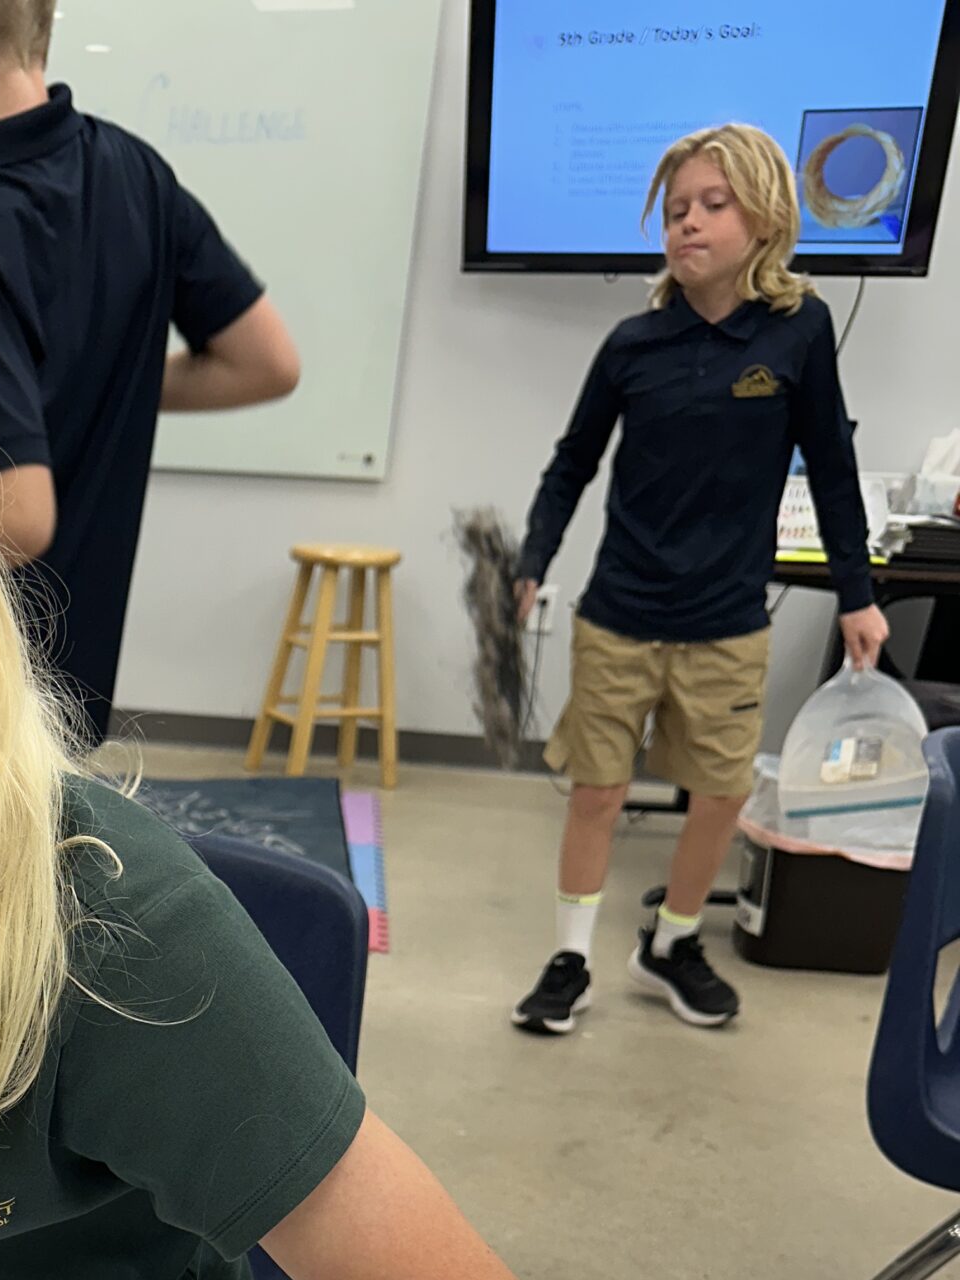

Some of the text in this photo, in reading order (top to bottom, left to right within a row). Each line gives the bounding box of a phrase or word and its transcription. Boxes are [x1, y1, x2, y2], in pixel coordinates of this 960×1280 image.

[557, 32, 583, 47] 5th
[588, 28, 636, 46] Grade
[653, 24, 714, 43] Today's
